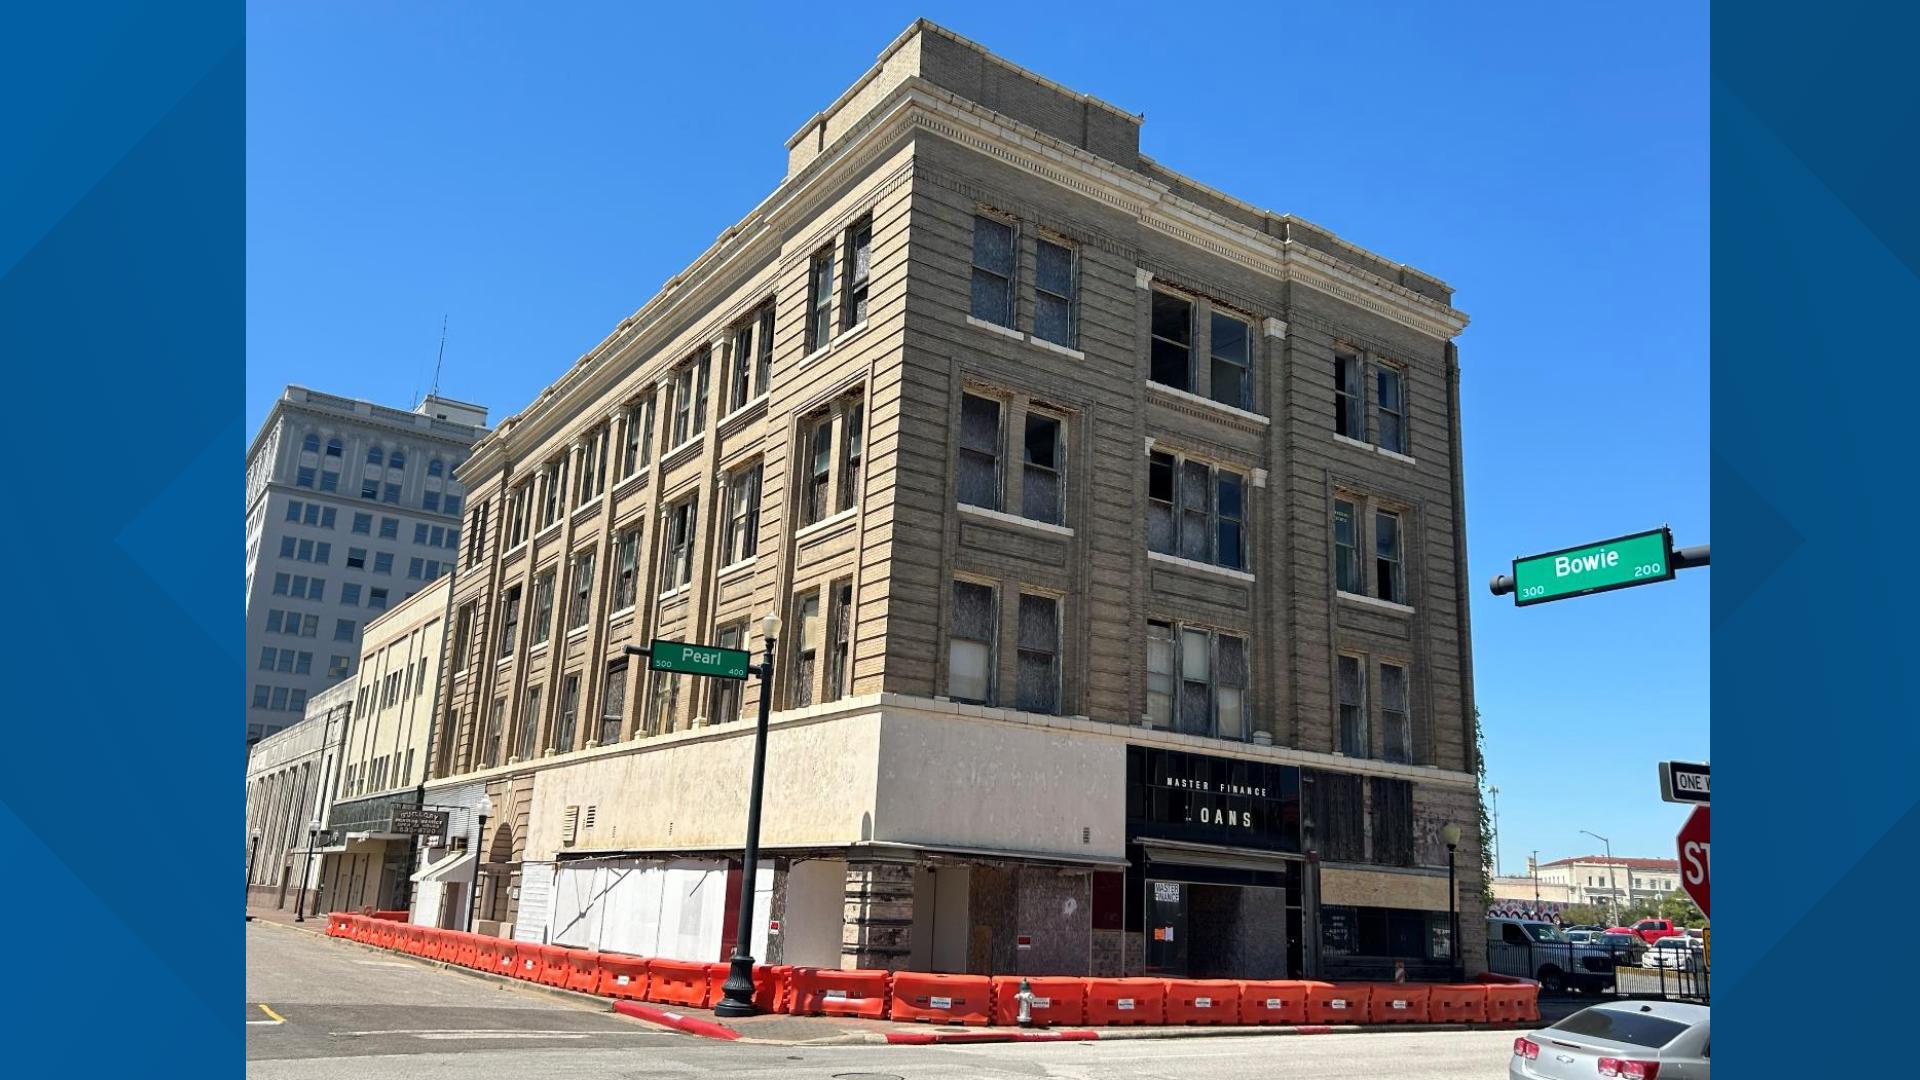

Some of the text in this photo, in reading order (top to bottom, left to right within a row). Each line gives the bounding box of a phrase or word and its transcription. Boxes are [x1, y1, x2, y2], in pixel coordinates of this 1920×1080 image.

[1555, 548, 1619, 577] Bowie
[1634, 563, 1661, 577] 200
[1522, 585, 1544, 597] 300
[656, 660, 672, 668] 500
[682, 648, 721, 665] Pearl
[728, 668, 744, 676] 400
[1166, 777, 1267, 797] MASTER FINANCE
[1679, 774, 1703, 790] ONE
[1185, 805, 1251, 827] OANS
[1155, 883, 1179, 893] MASTER
